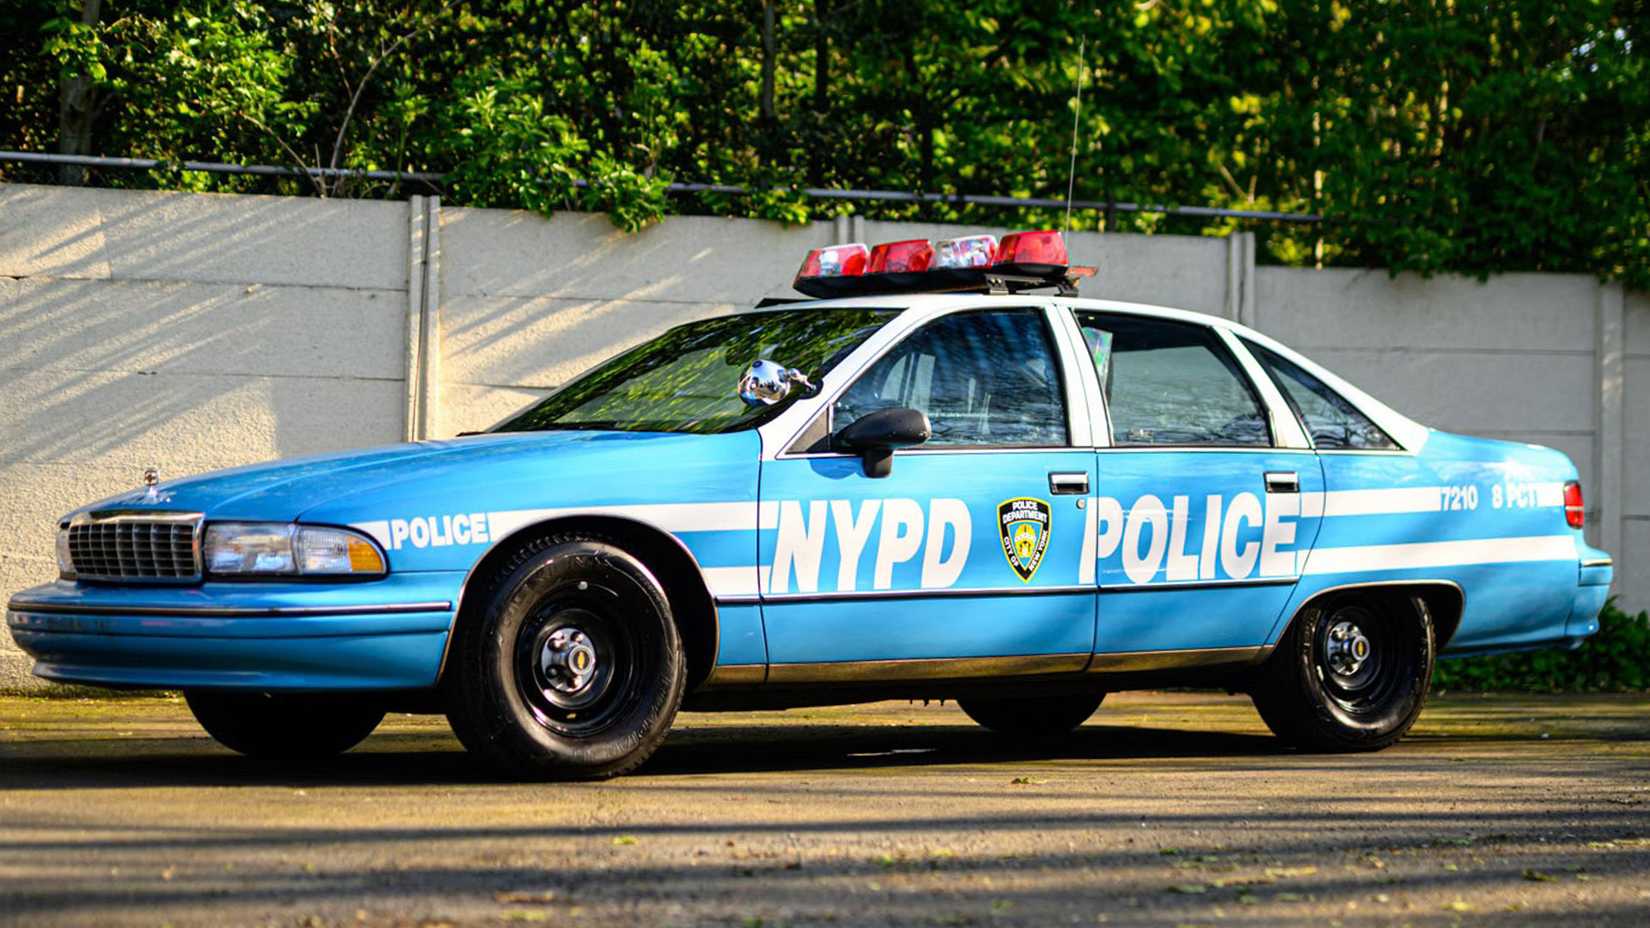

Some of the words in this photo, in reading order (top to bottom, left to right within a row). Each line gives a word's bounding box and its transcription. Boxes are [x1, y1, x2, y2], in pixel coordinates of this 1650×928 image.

[1012, 500, 1038, 510] POLICE
[1441, 485, 1478, 511] 7210
[1491, 484, 1503, 509] 8
[1003, 510, 1047, 524] DEPARTMENT
[391, 513, 488, 550] POLICE
[1079, 492, 1299, 584] POLICE
[770, 498, 972, 593] NYPD
[1004, 536, 1013, 554] CITY
